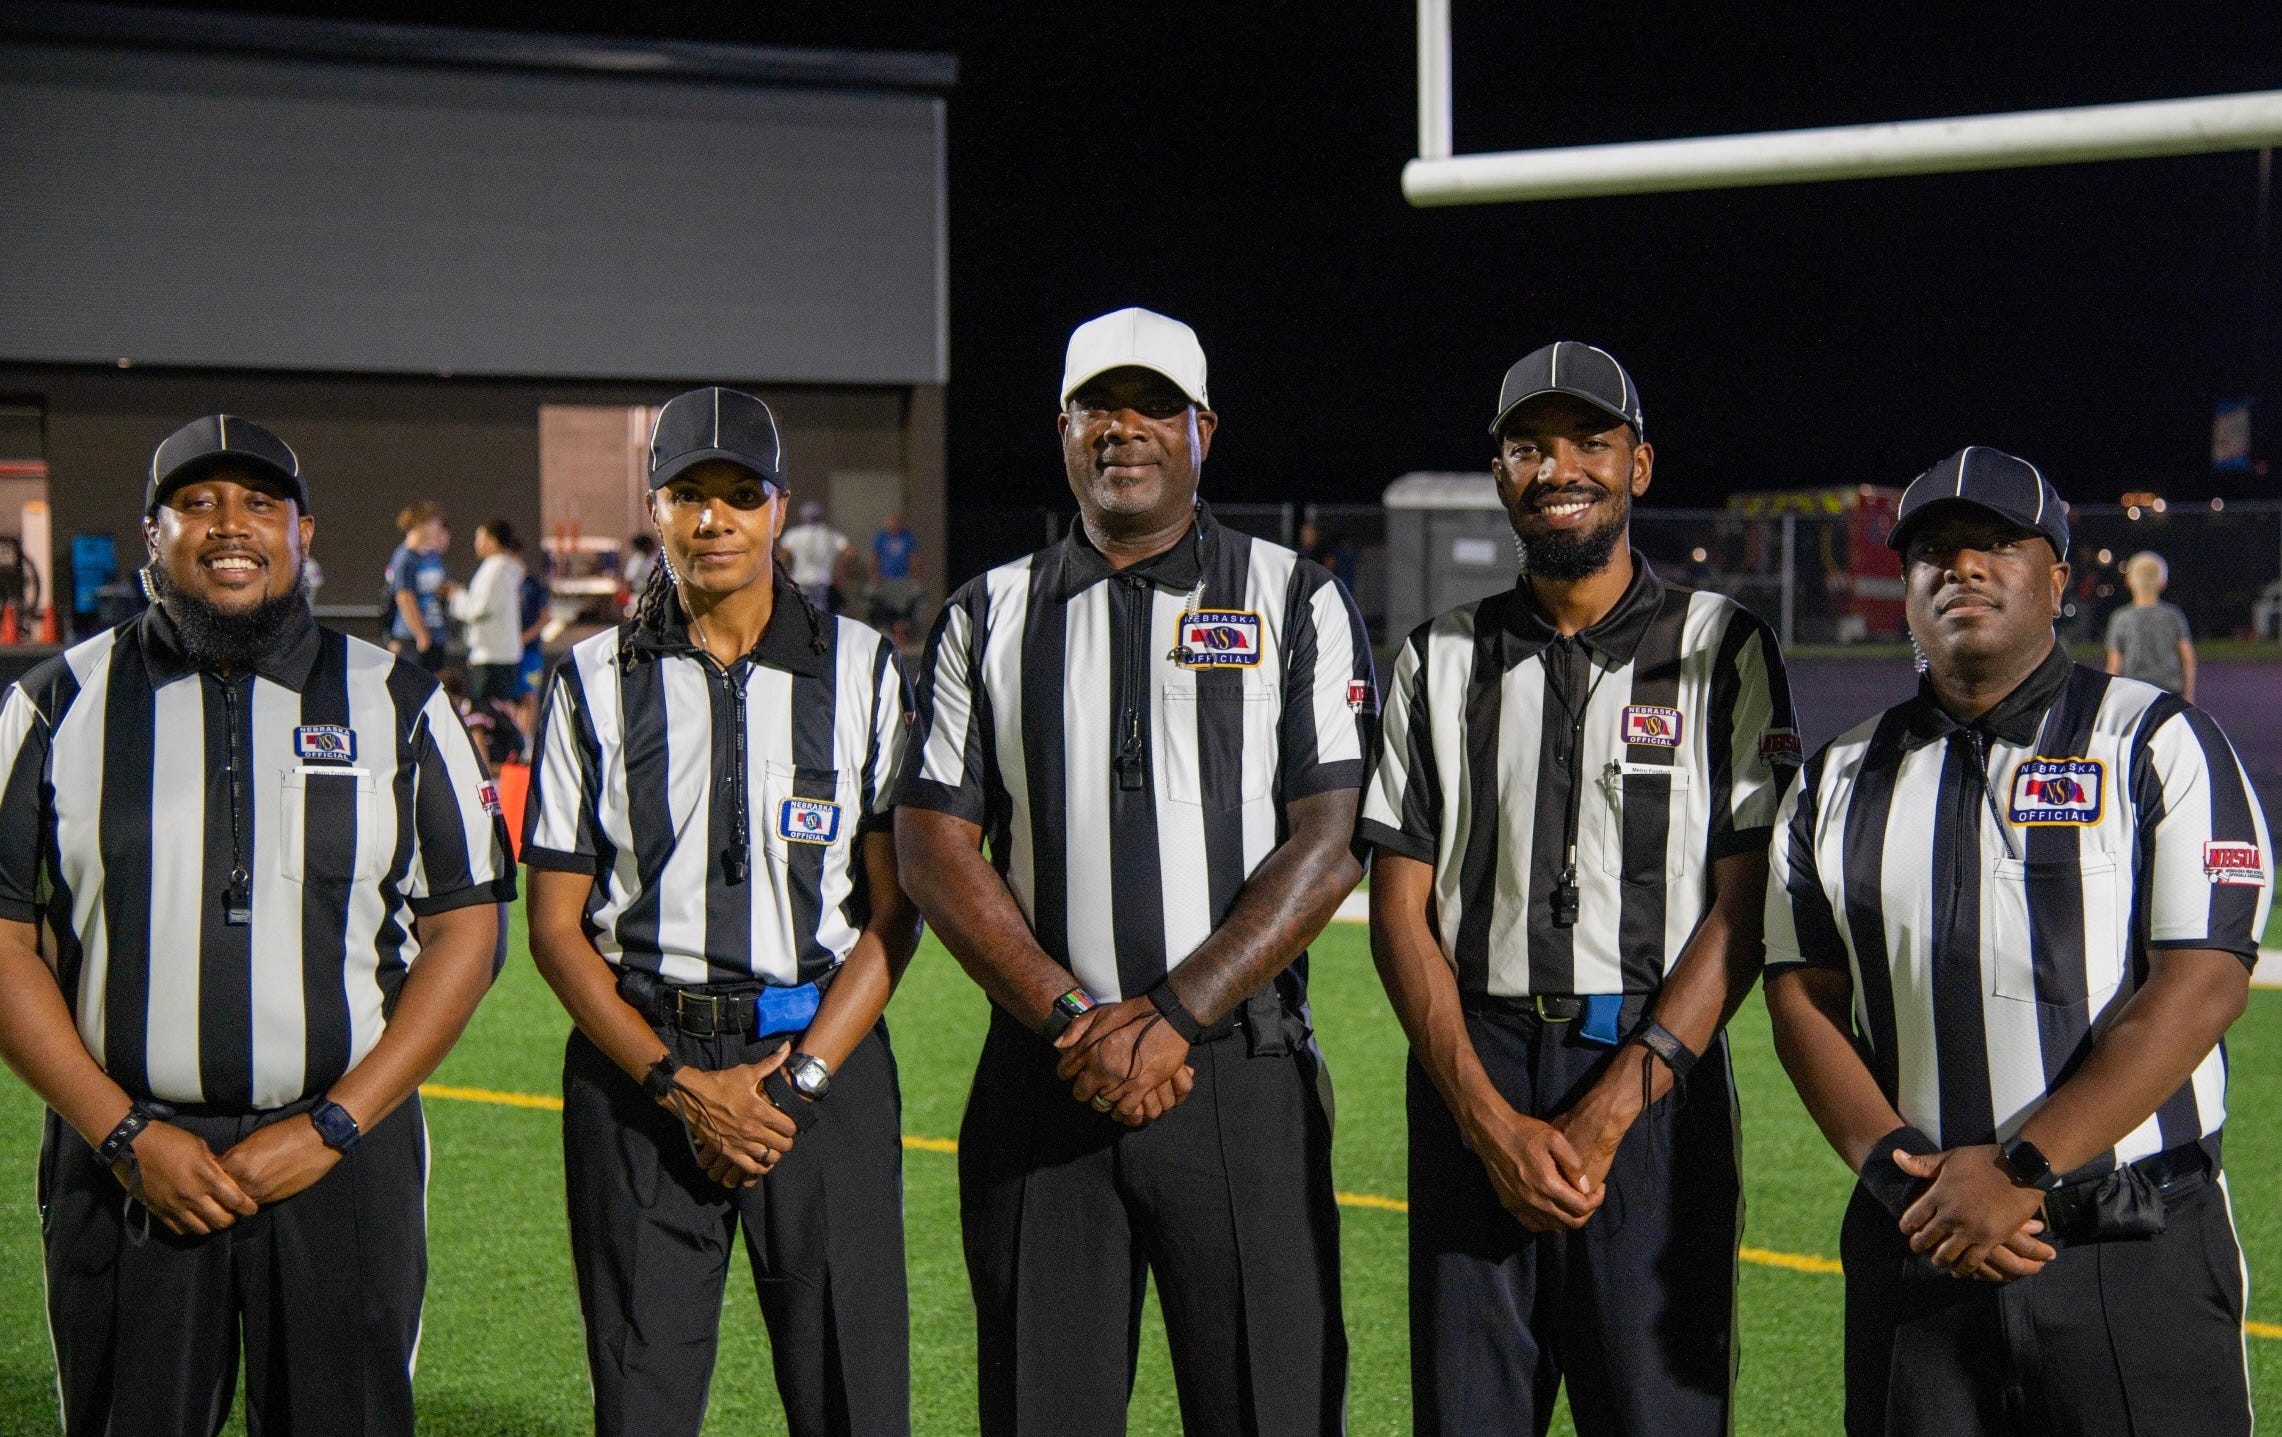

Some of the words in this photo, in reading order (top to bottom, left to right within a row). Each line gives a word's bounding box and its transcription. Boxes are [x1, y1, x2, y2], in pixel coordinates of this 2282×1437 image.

[1184, 614, 1256, 623] NEBRASKA
[1628, 706, 1678, 717] NEBRASKA
[300, 726, 351, 736] NEBRASKA
[1629, 736, 1673, 746] OFFICIAL
[304, 752, 349, 760] OFFICIAL
[2020, 762, 2097, 773] NEBRASKA
[790, 800, 834, 813] NEBRASKA
[2019, 811, 2089, 822] OFFICIAL
[790, 831, 826, 841] OFFICIAL
[2208, 848, 2261, 869] NHSOA
